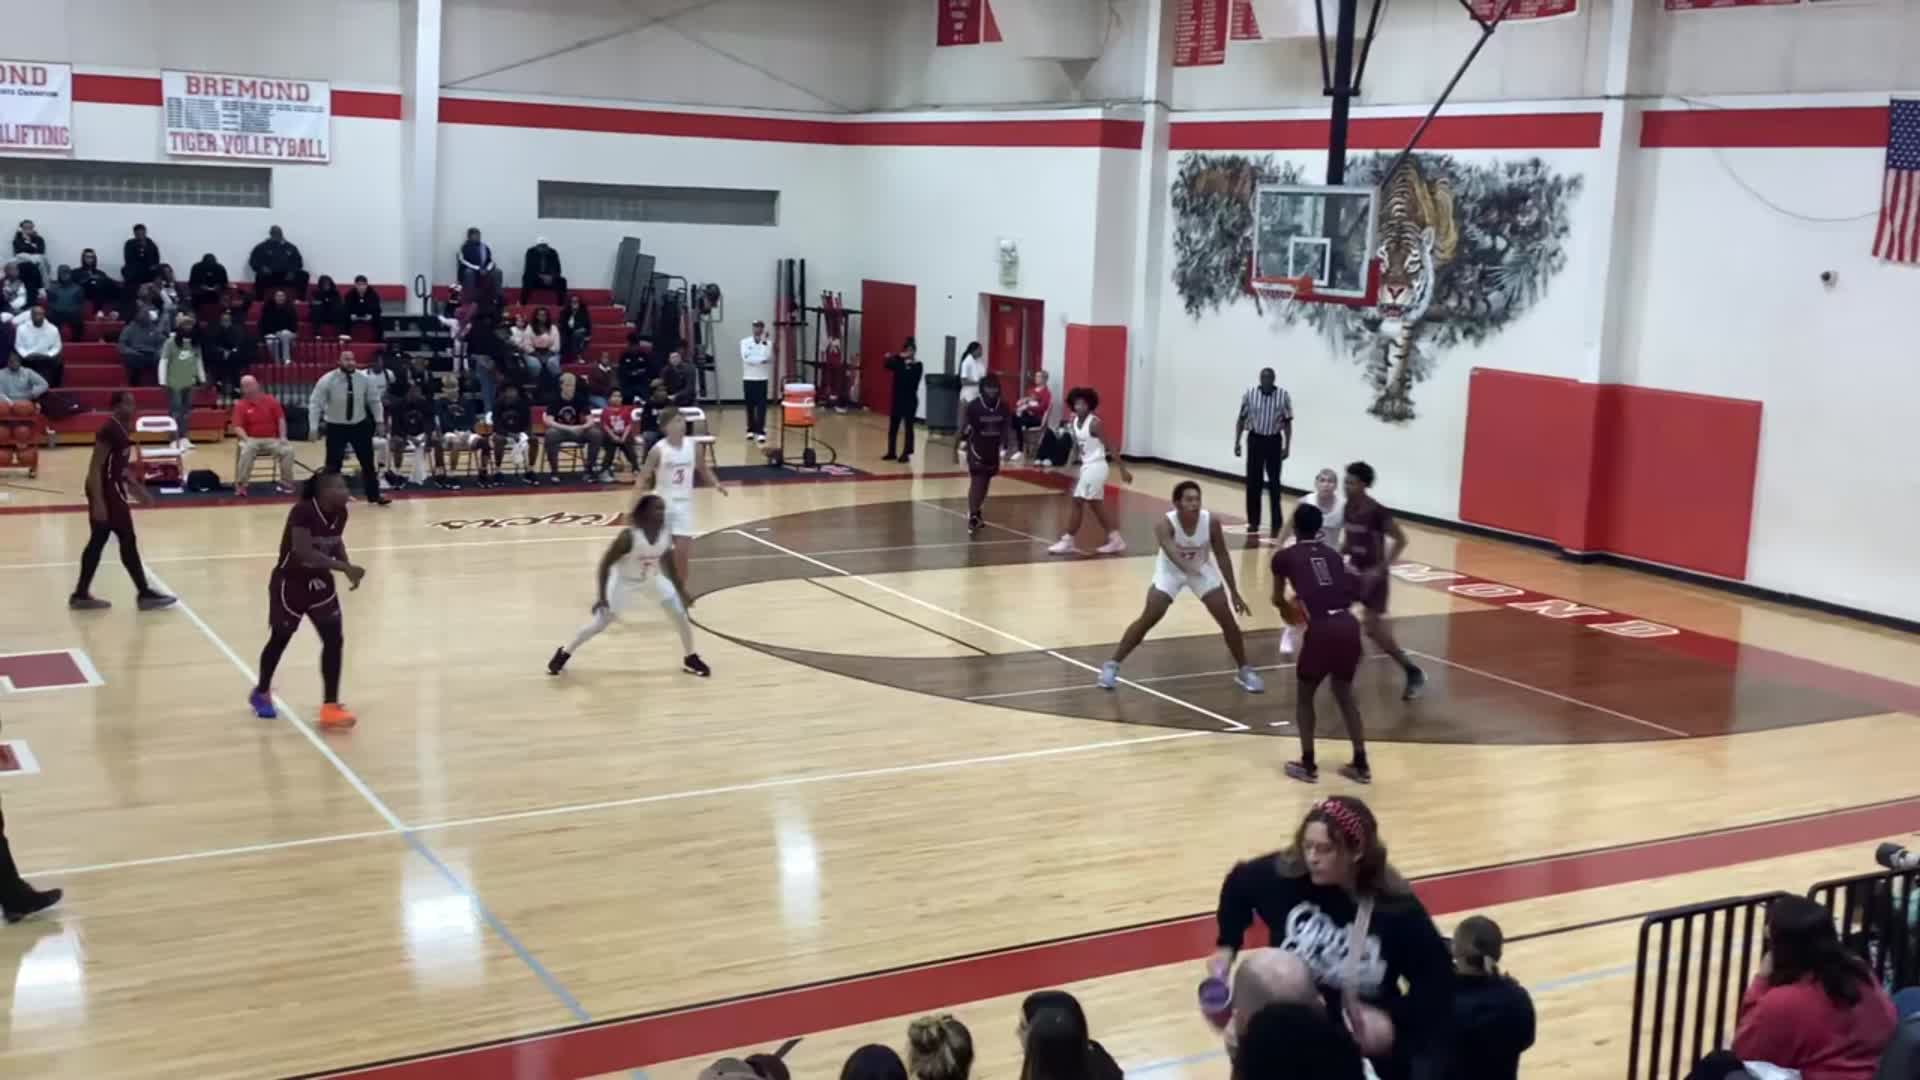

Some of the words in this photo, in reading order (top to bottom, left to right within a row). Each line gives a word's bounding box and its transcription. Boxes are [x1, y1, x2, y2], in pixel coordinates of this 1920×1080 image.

[186, 75, 310, 102] BREMOND
[0, 123, 69, 146] LIFTING
[169, 131, 216, 152] TIGER
[222, 133, 327, 158] VOLLEYBALL
